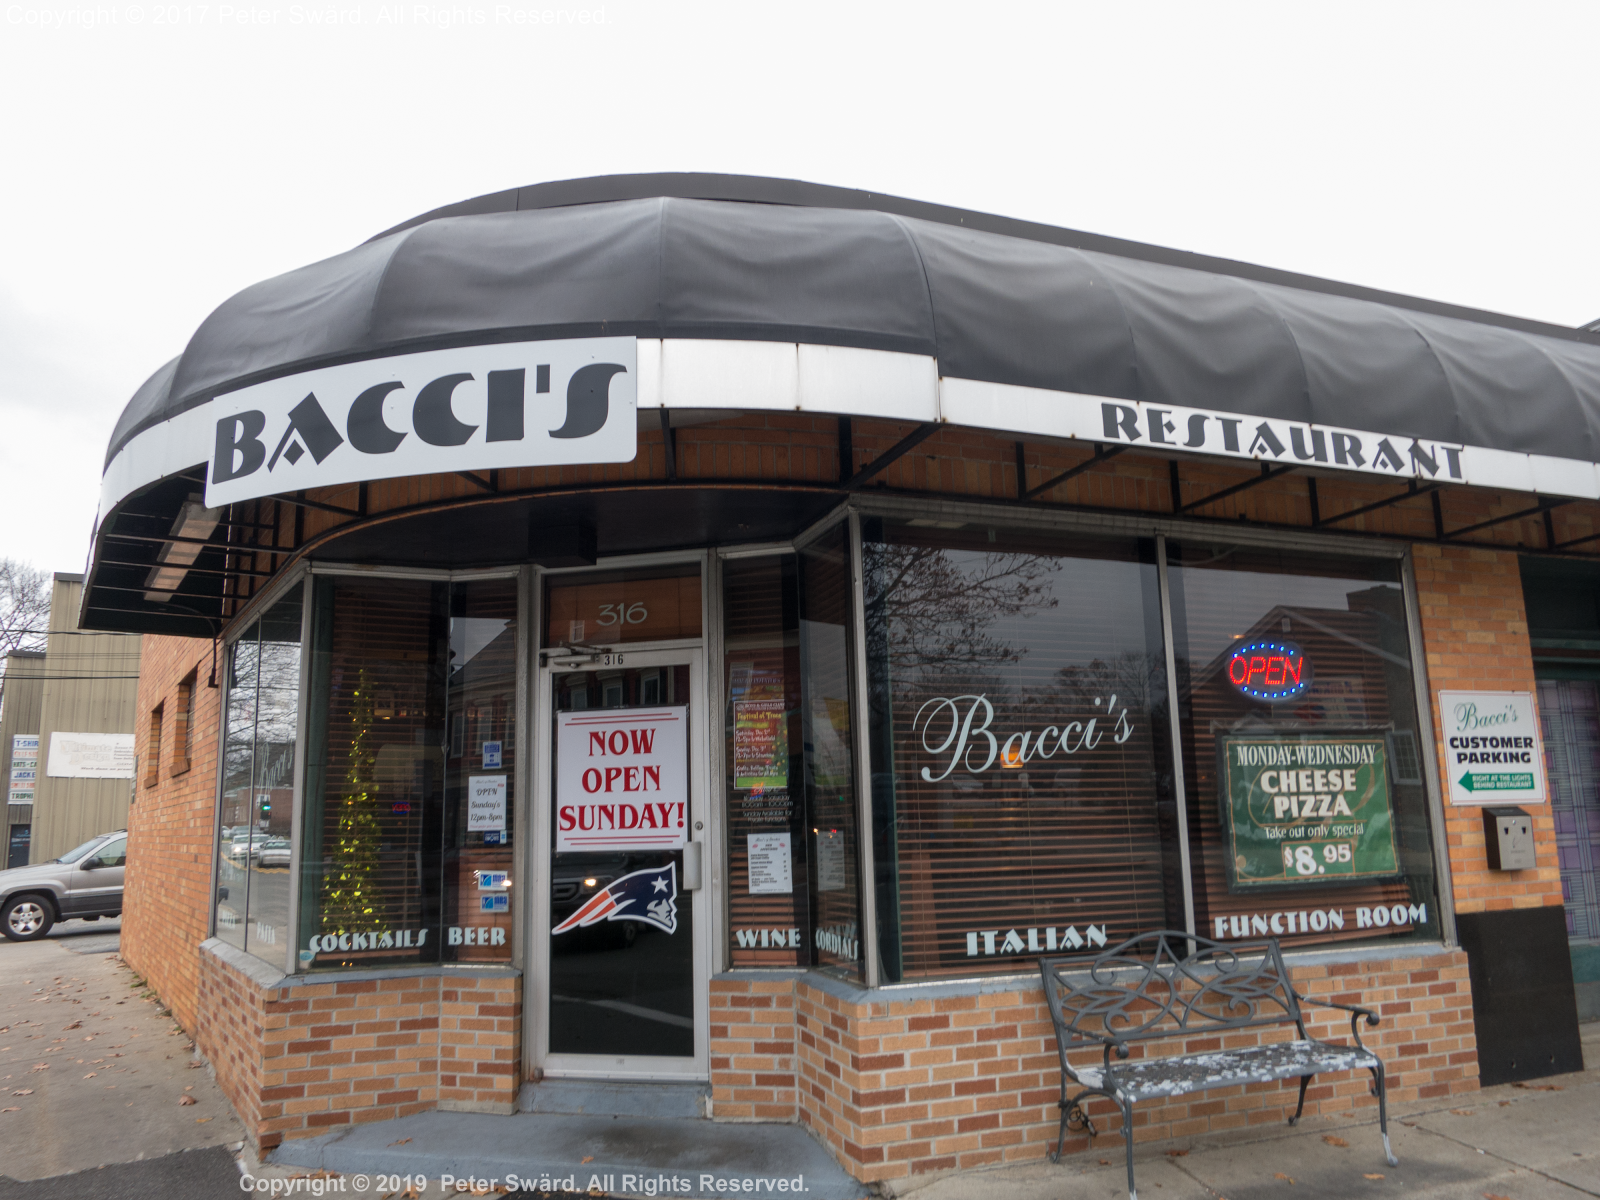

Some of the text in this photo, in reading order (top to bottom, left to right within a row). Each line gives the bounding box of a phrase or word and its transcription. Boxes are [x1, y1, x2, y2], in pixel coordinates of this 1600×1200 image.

[211, 362, 628, 485] BACCI'S
[1100, 401, 1465, 480] RESTAURANT
[596, 602, 648, 626] 316
[604, 653, 624, 666] 316
[1229, 656, 1303, 685] OPEN
[1453, 702, 1519, 732] Bacci's
[588, 728, 656, 757] NOW
[912, 692, 1135, 783] Bacci's
[1450, 736, 1533, 749] CUSTOMER
[1237, 744, 1376, 766] MONDAY-WEDNESDAY
[1456, 752, 1531, 764] PARKING
[581, 765, 661, 794] OPEN
[1260, 769, 1357, 793] CHEESE
[1473, 780, 1532, 789] BEHIND RESTAURANT
[1511, 774, 1531, 782] LIGHTS
[475, 788, 498, 797] OPEN
[471, 801, 501, 811] Sunday's
[559, 802, 685, 831] SUNDAY!
[1273, 794, 1351, 819] PIZZA
[1264, 823, 1364, 839] Take out only special
[1284, 844, 1352, 875] $8.95
[1214, 902, 1427, 939] FUNCTION ROOM
[309, 928, 429, 952] COCKTAILS
[448, 926, 507, 946] BEER
[735, 928, 801, 948] WINE
[815, 929, 859, 960] CORDIALS
[966, 924, 1108, 956] ITALIAN
